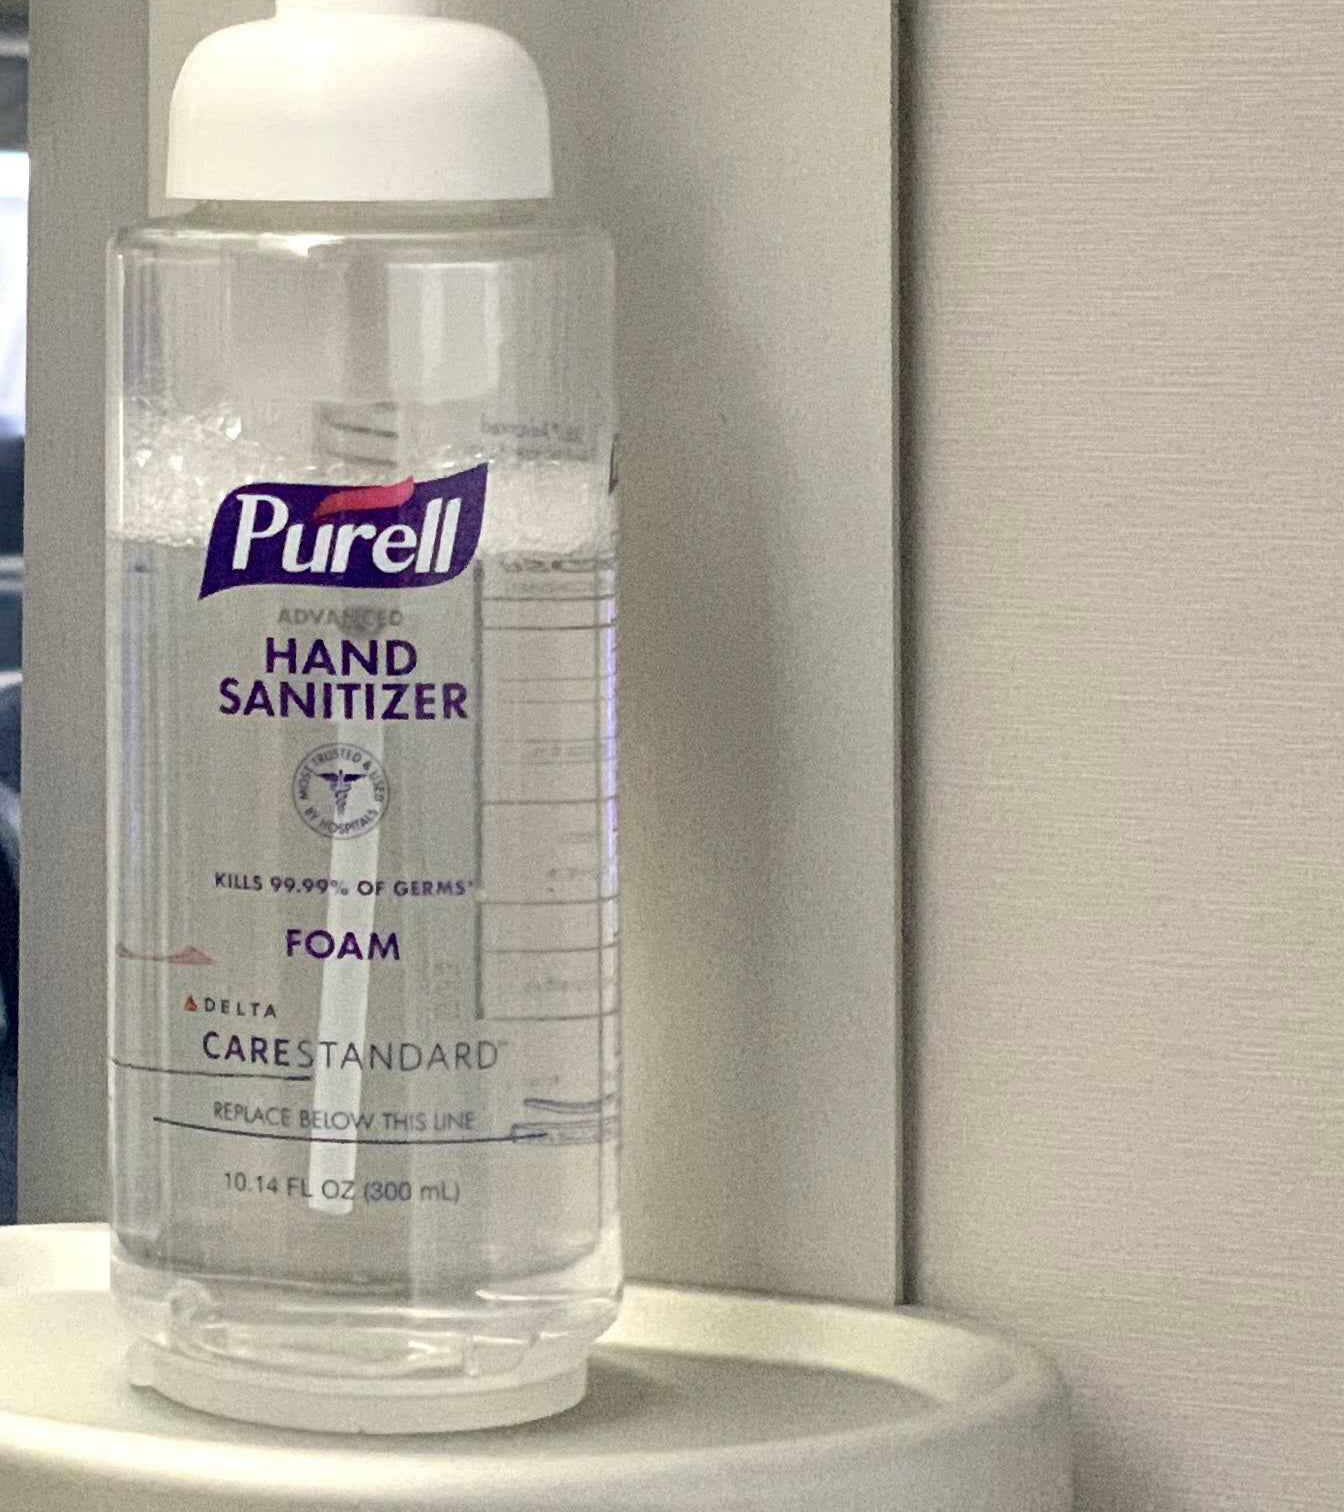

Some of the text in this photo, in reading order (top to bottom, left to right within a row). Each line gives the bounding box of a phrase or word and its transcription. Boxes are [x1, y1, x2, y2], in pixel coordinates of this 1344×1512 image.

[232, 493, 462, 575] Purell
[266, 637, 418, 676] HAND
[219, 677, 468, 720] SANITIZER
[214, 872, 263, 891] KILLS
[270, 876, 349, 896] 99.99%
[356, 880, 384, 896] OF
[285, 929, 400, 960] FOAM
[204, 997, 277, 1019] DELTA
[213, 1101, 475, 1131] REPLACE BELOW THIS LINE
[224, 1172, 460, 1203] 10.14 FL OZ (300 mL)
